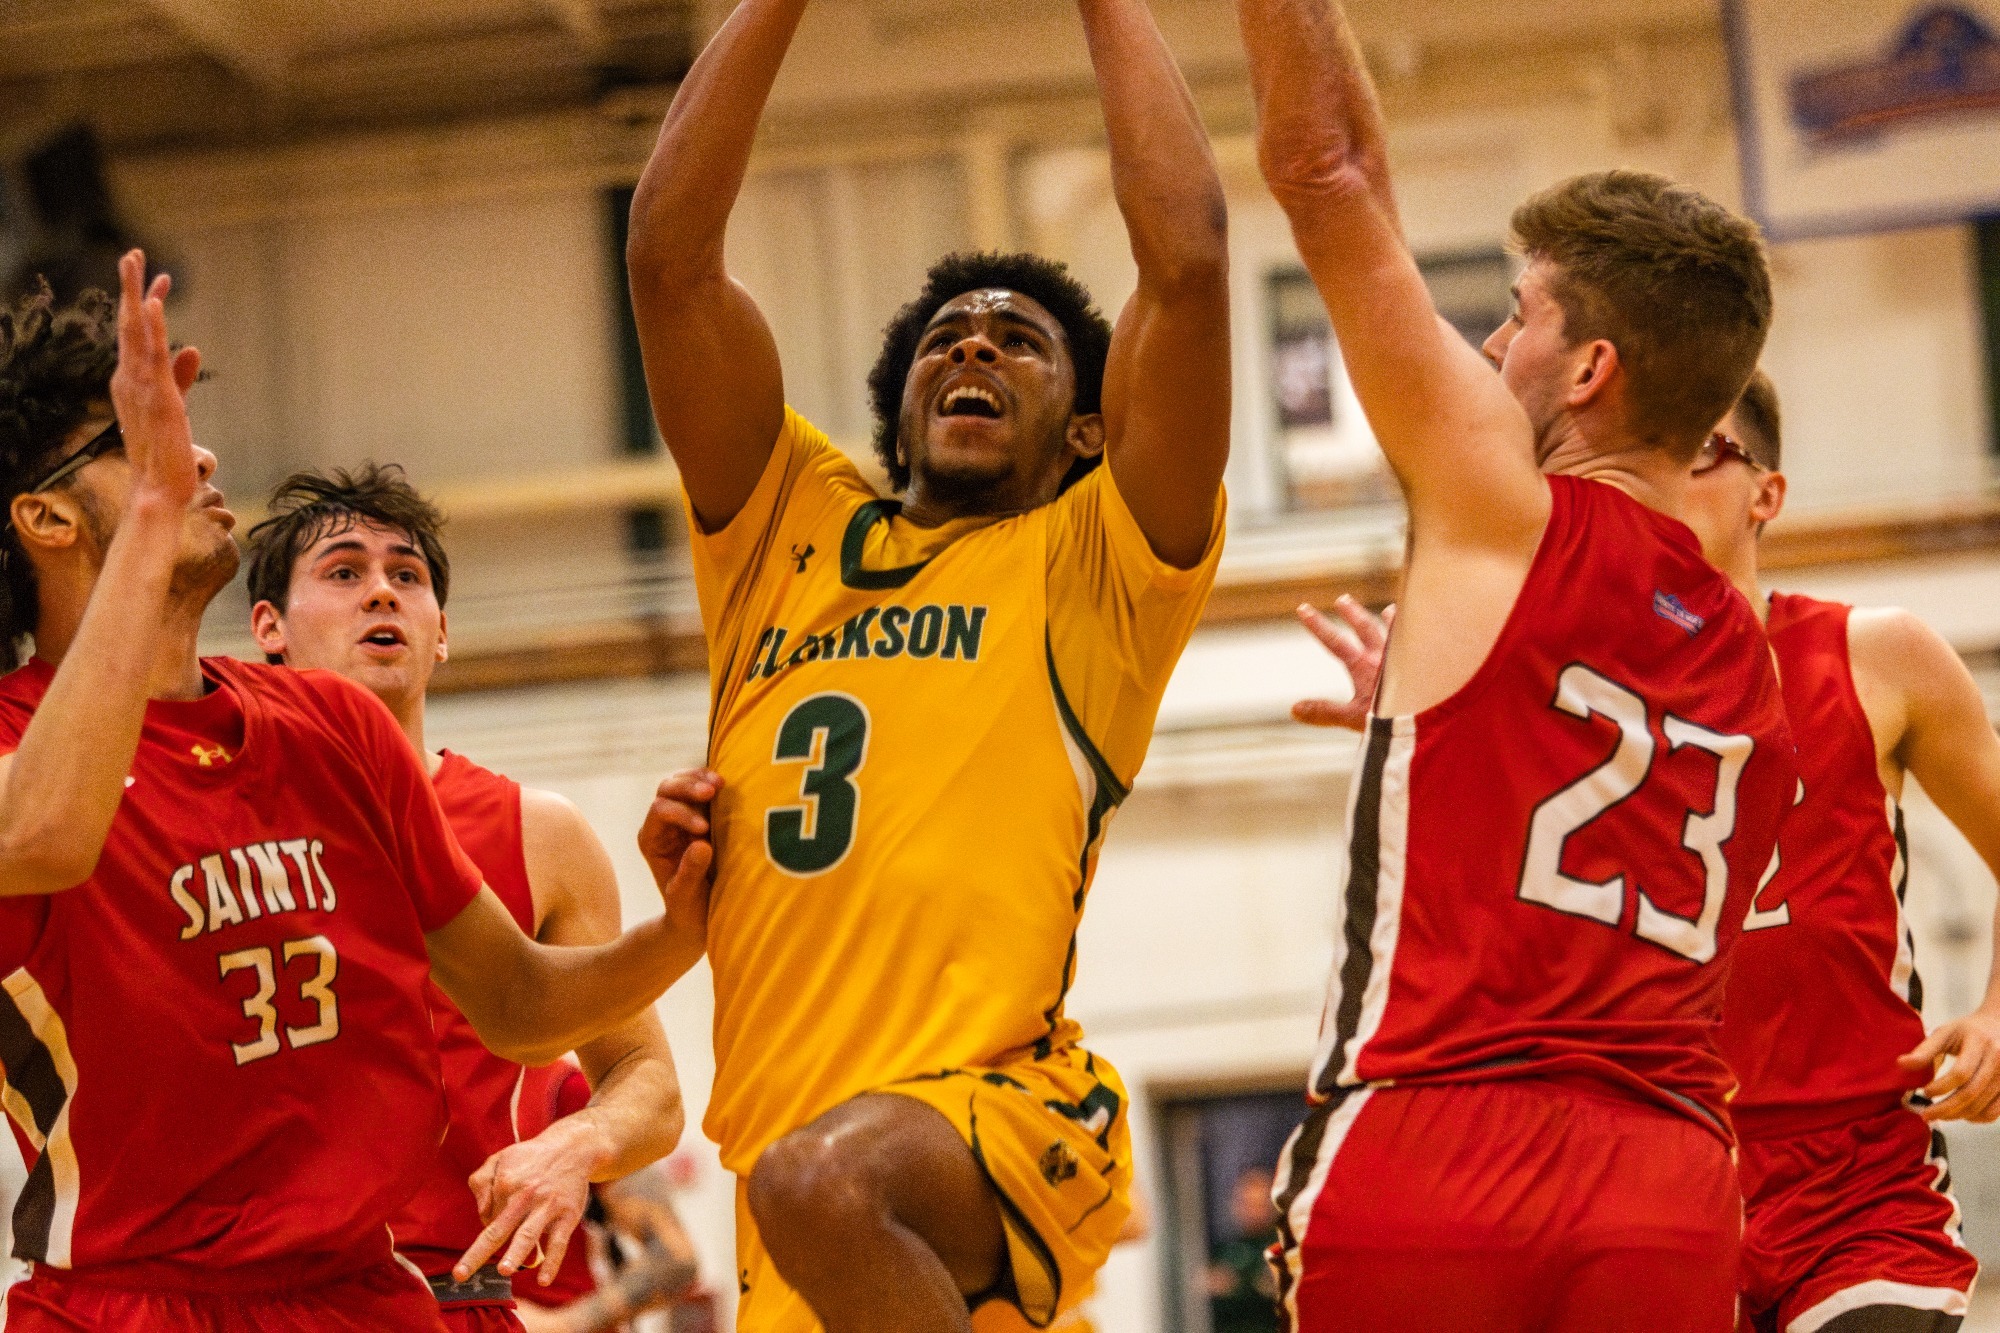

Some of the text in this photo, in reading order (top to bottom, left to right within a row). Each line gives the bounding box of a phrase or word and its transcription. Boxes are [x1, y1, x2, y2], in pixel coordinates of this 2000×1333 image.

[763, 690, 871, 879] 3
[1518, 660, 1755, 965] 23
[169, 837, 337, 942] SAINTS
[217, 934, 340, 1067] 33
